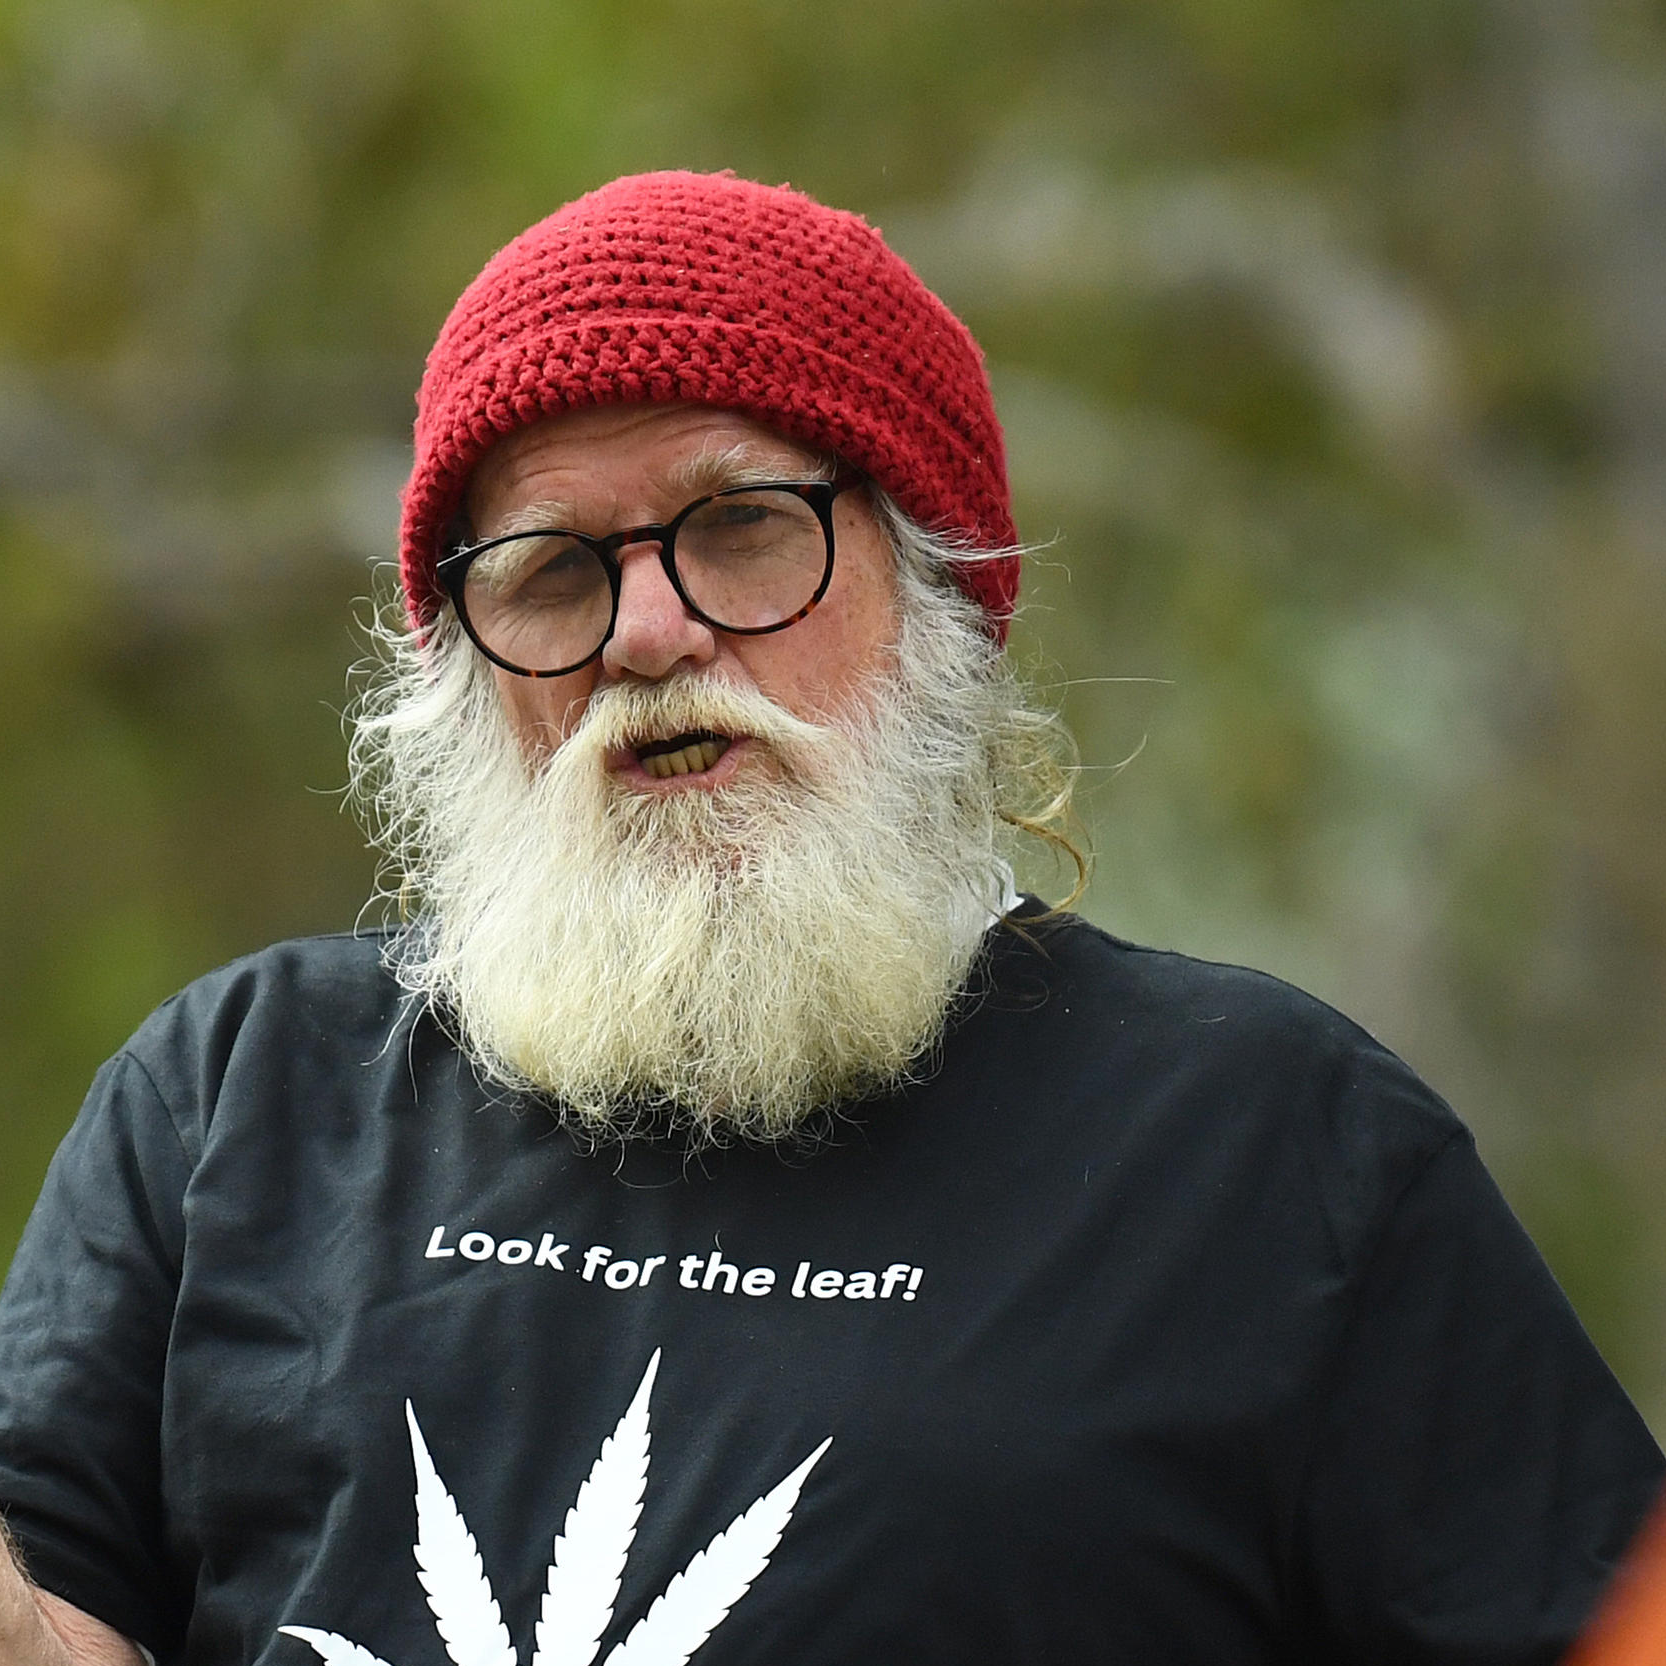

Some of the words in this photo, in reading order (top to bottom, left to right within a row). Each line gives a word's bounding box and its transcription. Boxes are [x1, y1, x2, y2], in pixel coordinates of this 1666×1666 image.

[425, 1226, 570, 1271] Look
[581, 1246, 666, 1290] for
[678, 1251, 776, 1296] the
[791, 1262, 924, 1301] leaf!
